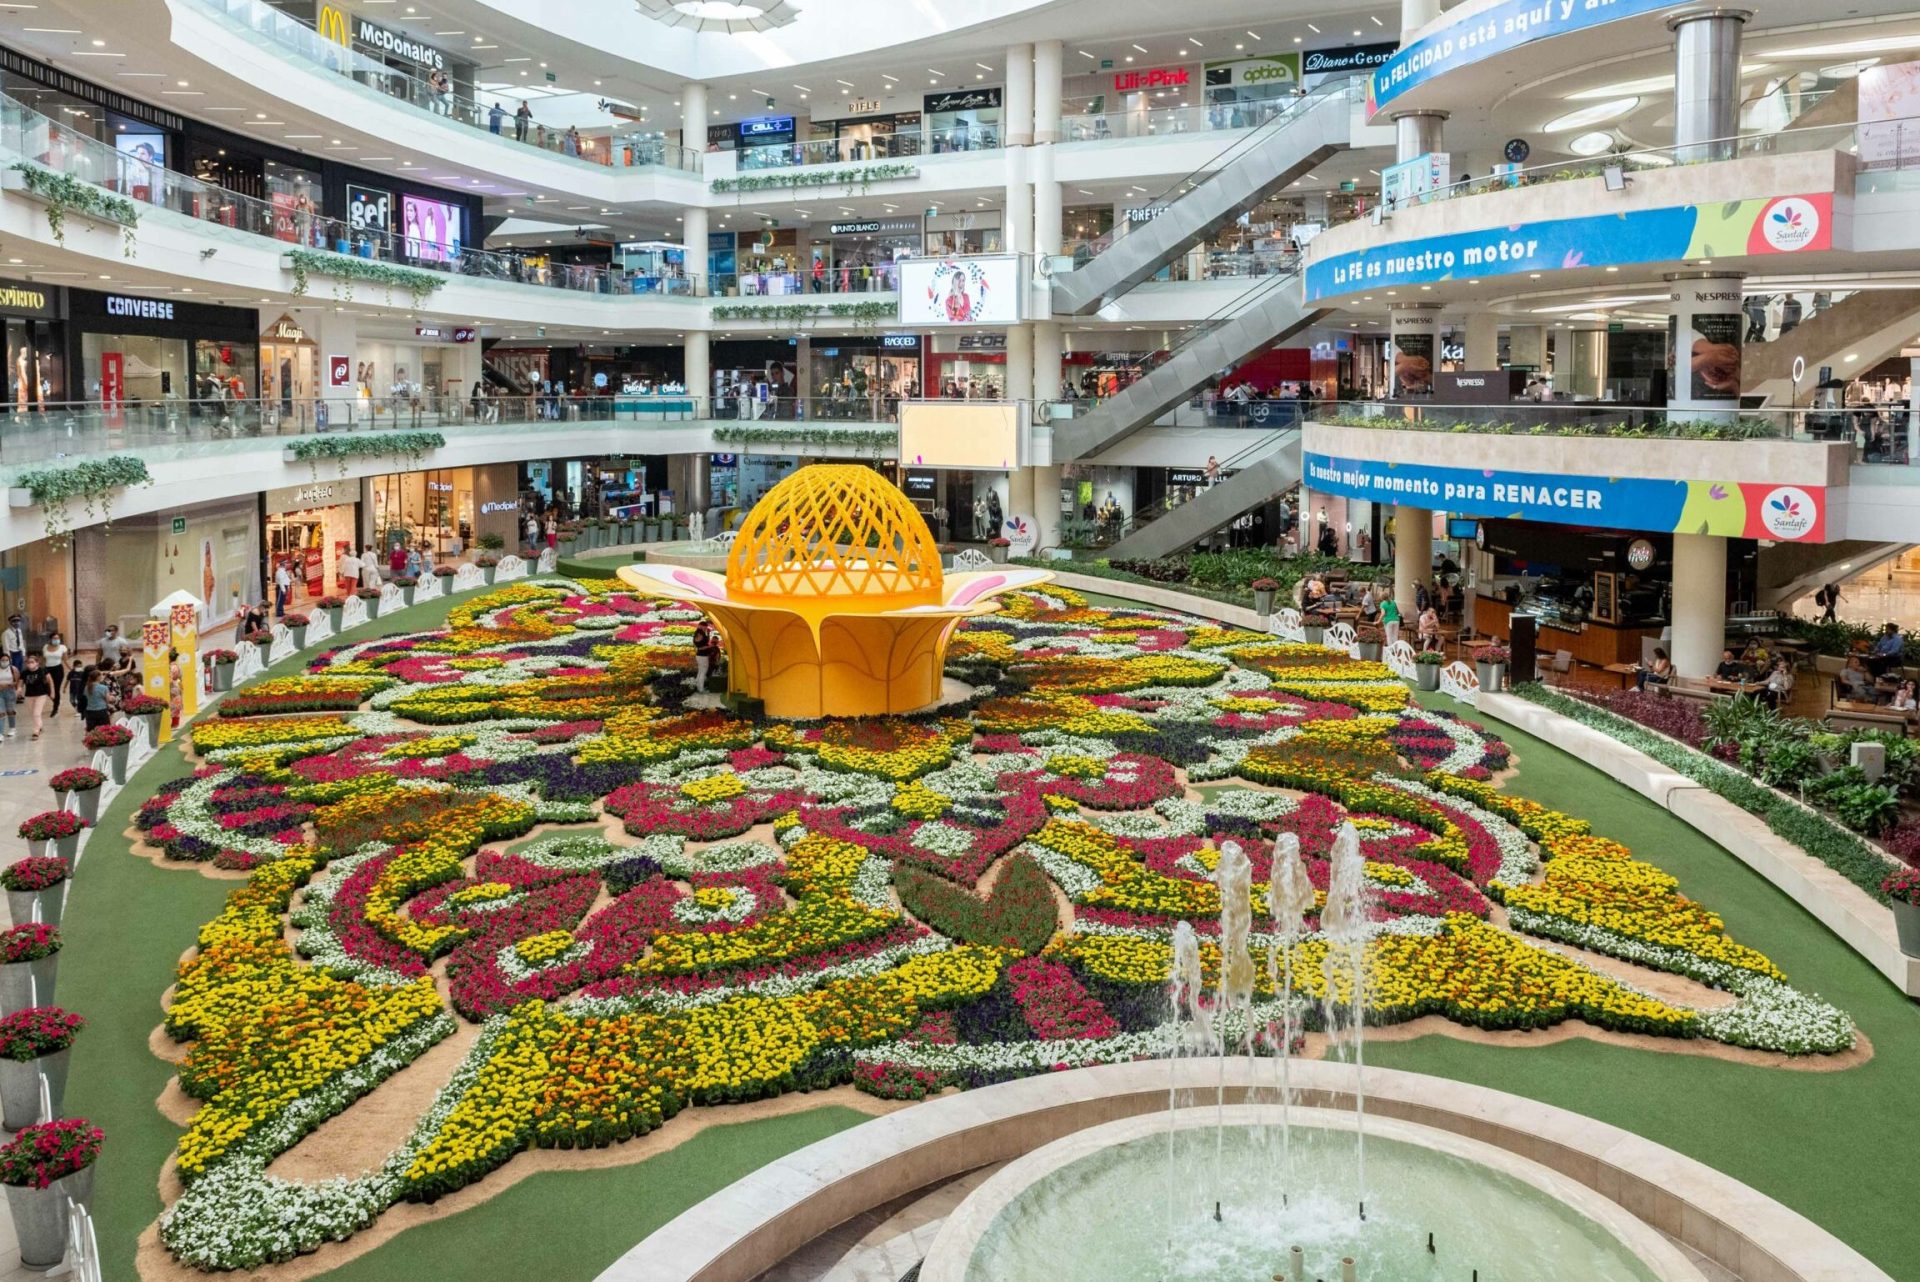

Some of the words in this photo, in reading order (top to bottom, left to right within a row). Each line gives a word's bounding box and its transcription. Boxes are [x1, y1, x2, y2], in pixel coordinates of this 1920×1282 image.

[360, 21, 443, 69] McDonald's
[1380, 76, 1390, 94] La
[1391, 40, 1454, 86] FELICIDAD
[1459, 19, 1497, 50] está
[1560, 0, 1575, 20] y
[1115, 72, 1139, 91] Lili
[1149, 67, 1190, 86] Pink
[848, 101, 881, 113] RIFLE
[752, 123, 774, 131] CELL
[351, 197, 388, 231] gef
[1126, 207, 1169, 221] FOREVE
[837, 224, 857, 233] PUNTO
[857, 223, 879, 232] BLANCO
[1334, 266, 1346, 284] La
[1350, 261, 1363, 280] FE
[1367, 261, 1381, 277] es
[1386, 250, 1455, 275] nuestro
[1464, 239, 1538, 265] motor
[107, 296, 174, 320] CONVERSE
[276, 323, 303, 343] Maaji
[884, 336, 916, 347] RAGGED
[1172, 474, 1202, 482] ARTURO
[1317, 466, 1341, 483] nuestro
[1343, 469, 1371, 489] mejor
[1374, 475, 1439, 496] momento
[1445, 481, 1486, 501] para
[1493, 483, 1603, 510] RENACER
